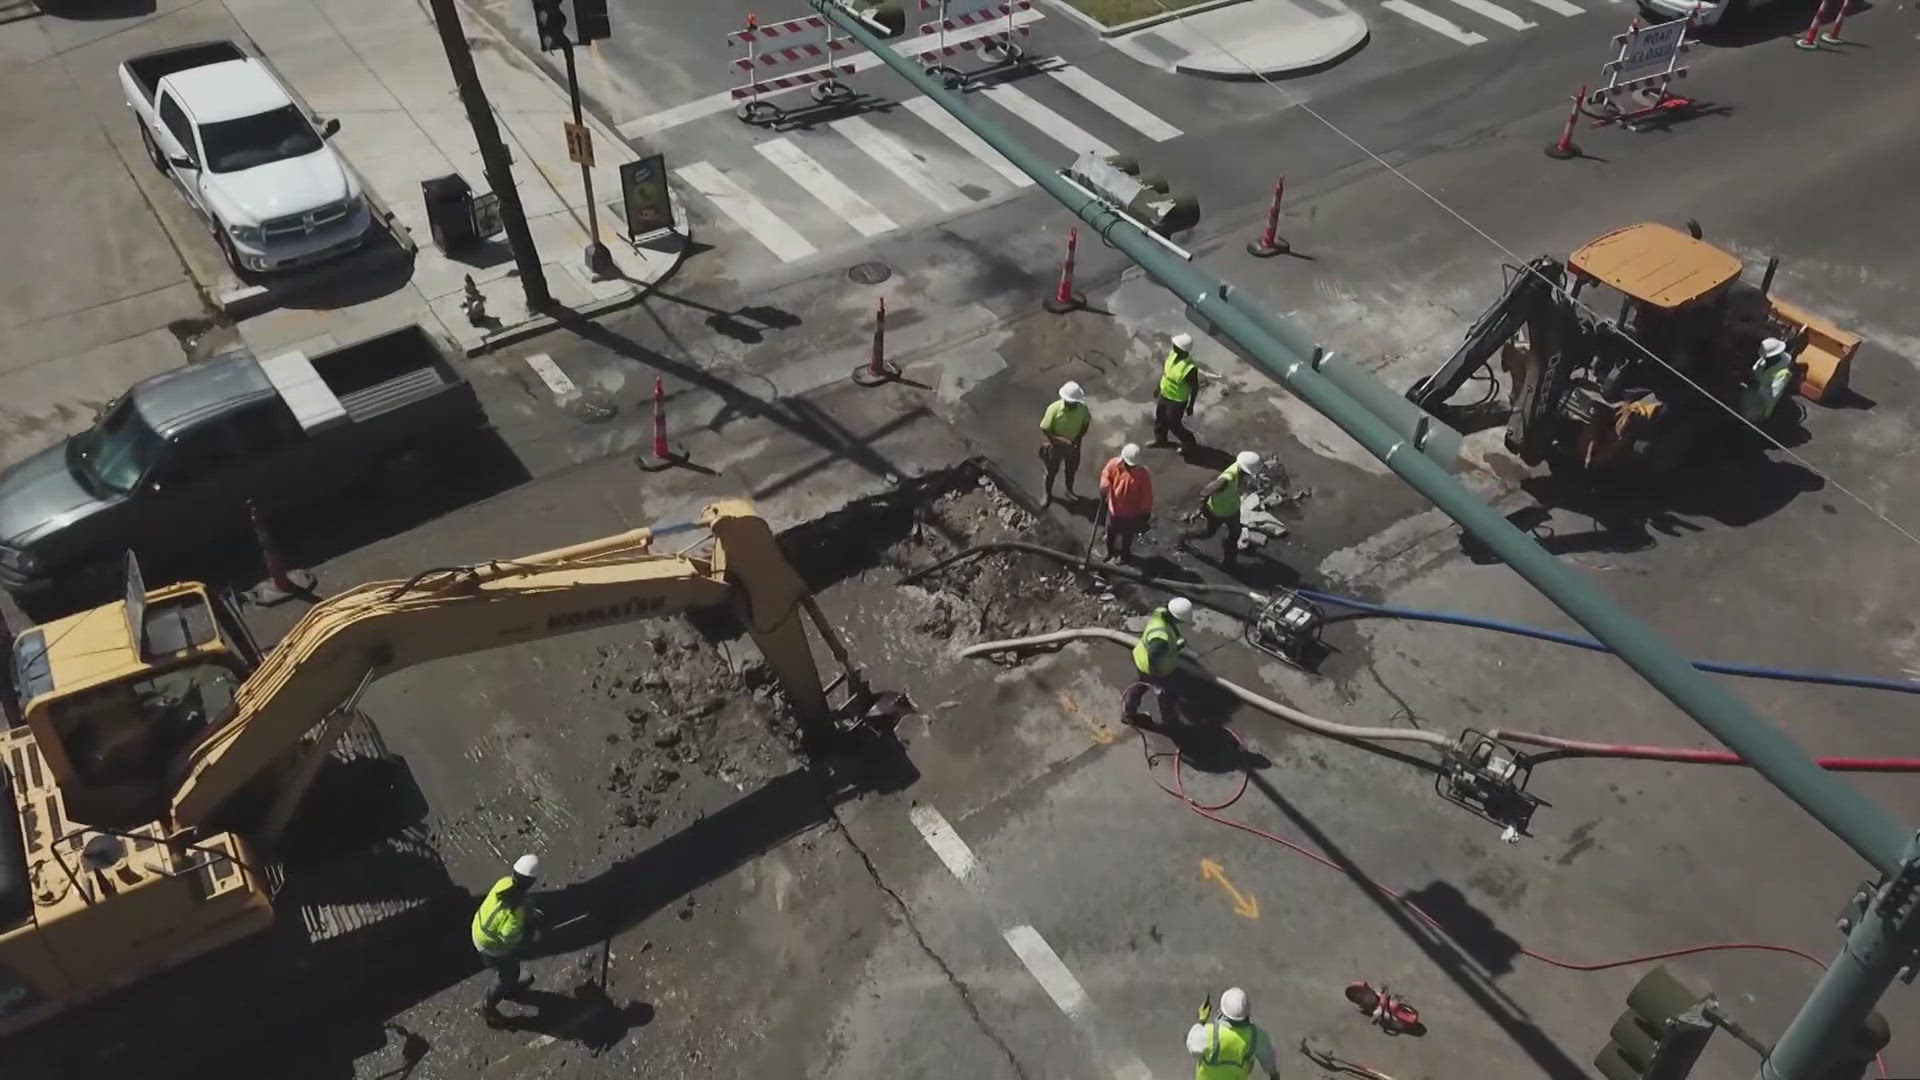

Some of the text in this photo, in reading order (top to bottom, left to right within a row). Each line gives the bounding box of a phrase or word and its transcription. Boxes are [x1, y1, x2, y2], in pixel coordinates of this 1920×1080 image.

[1643, 29, 1673, 46] ROAD
[1632, 44, 1672, 62] CLOSED
[1536, 352, 1561, 415] DEERE
[548, 596, 666, 628] KOMATSU
